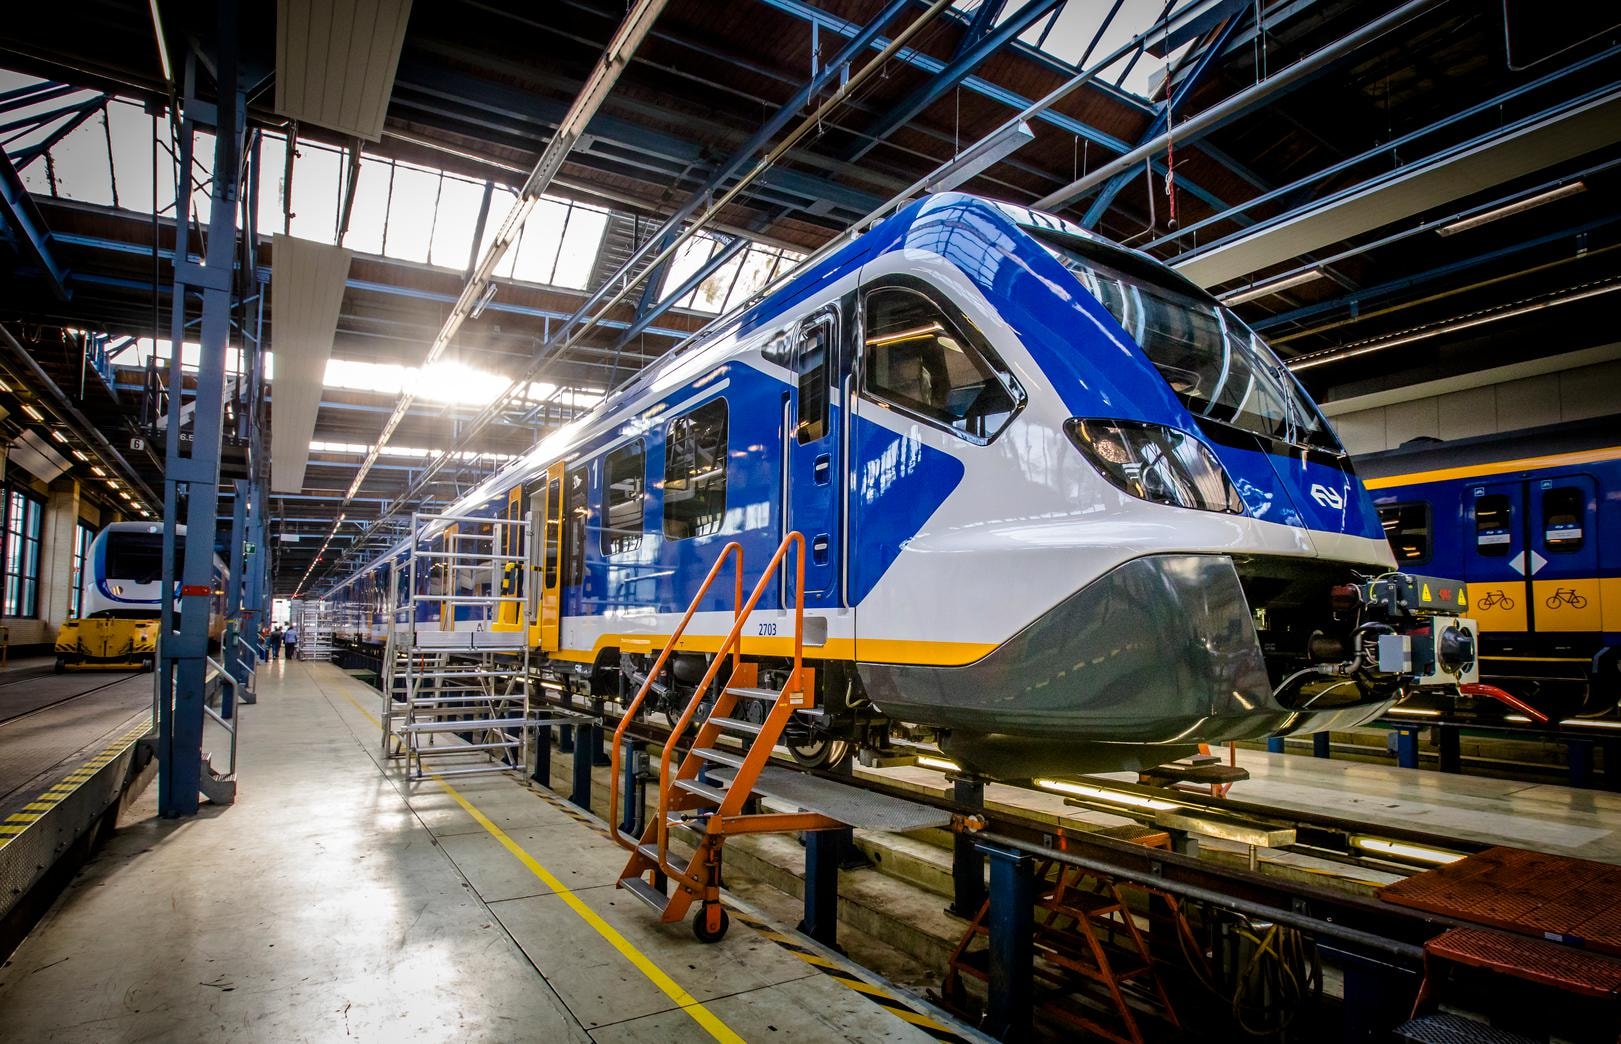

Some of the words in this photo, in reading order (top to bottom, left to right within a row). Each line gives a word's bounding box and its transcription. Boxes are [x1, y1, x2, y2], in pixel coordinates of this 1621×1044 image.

[134, 439, 140, 449] 6
[592, 458, 598, 489] 1
[758, 623, 777, 636] 2703
